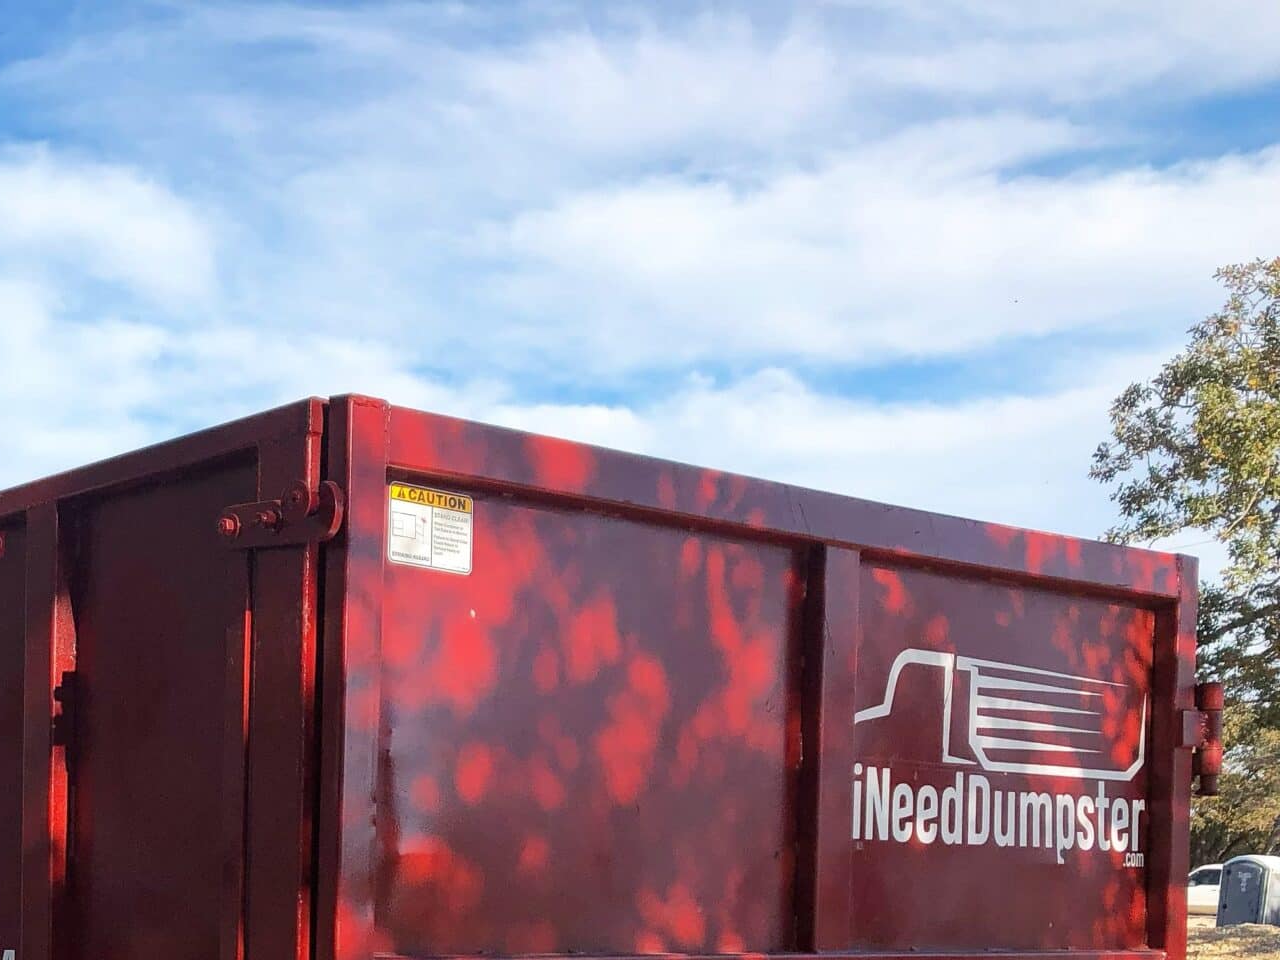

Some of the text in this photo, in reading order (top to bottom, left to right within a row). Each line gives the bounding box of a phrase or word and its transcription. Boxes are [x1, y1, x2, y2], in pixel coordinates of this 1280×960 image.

[408, 488, 466, 511] CAUTION
[852, 762, 1146, 865] iNeedDumpster
[1122, 851, 1145, 868] .com
